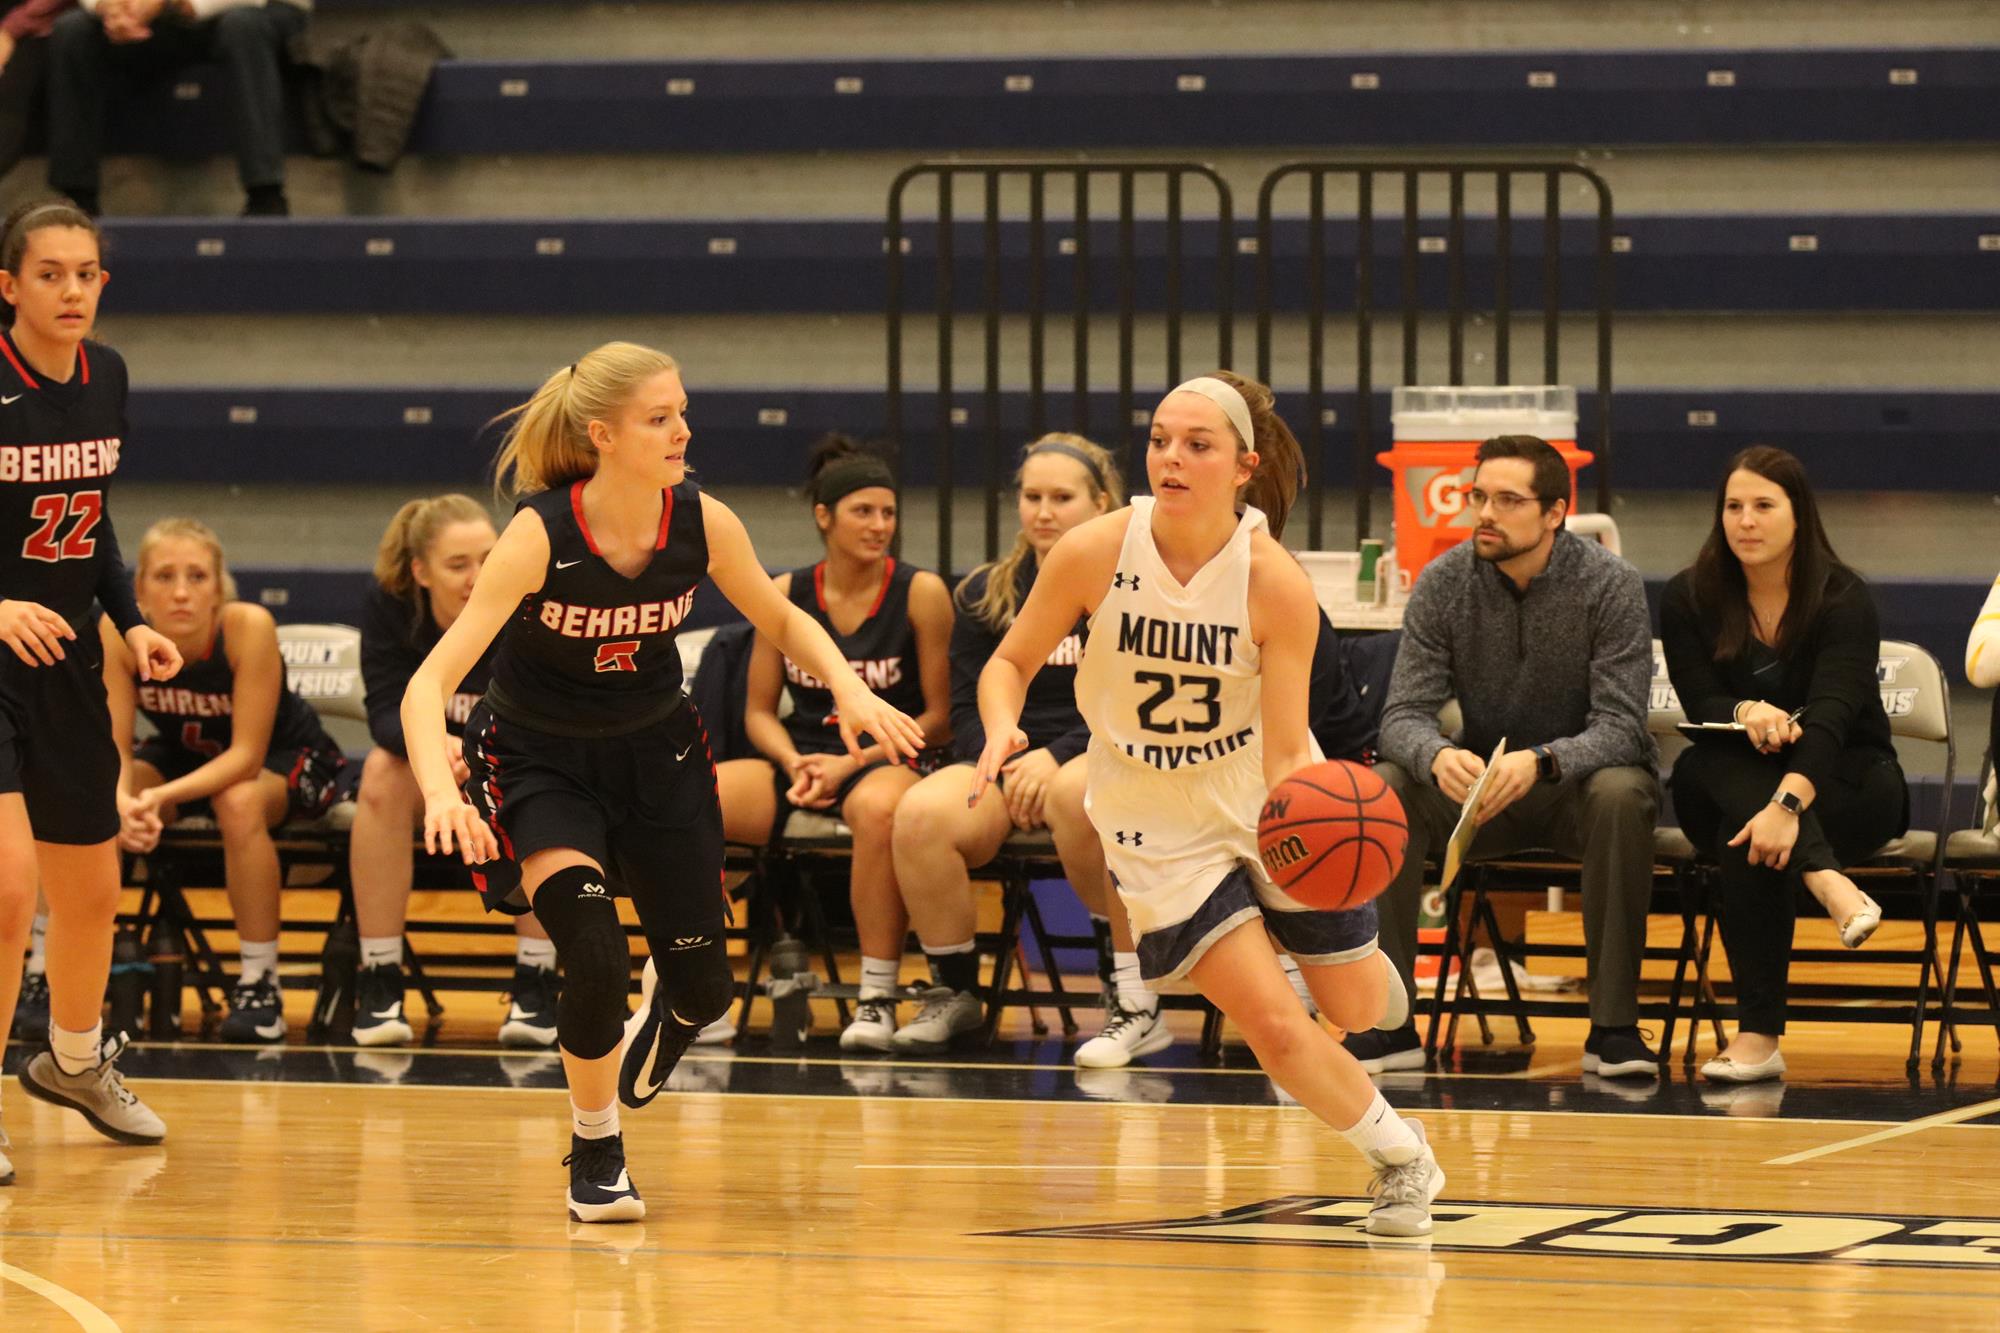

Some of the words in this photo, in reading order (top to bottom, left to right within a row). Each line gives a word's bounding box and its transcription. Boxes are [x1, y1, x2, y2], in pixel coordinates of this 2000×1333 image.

[22, 490, 102, 562] 22
[279, 640, 353, 664] OUNT
[1117, 612, 1239, 666] MOUNT
[138, 687, 233, 716] EHREN
[1134, 671, 1221, 733] 23
